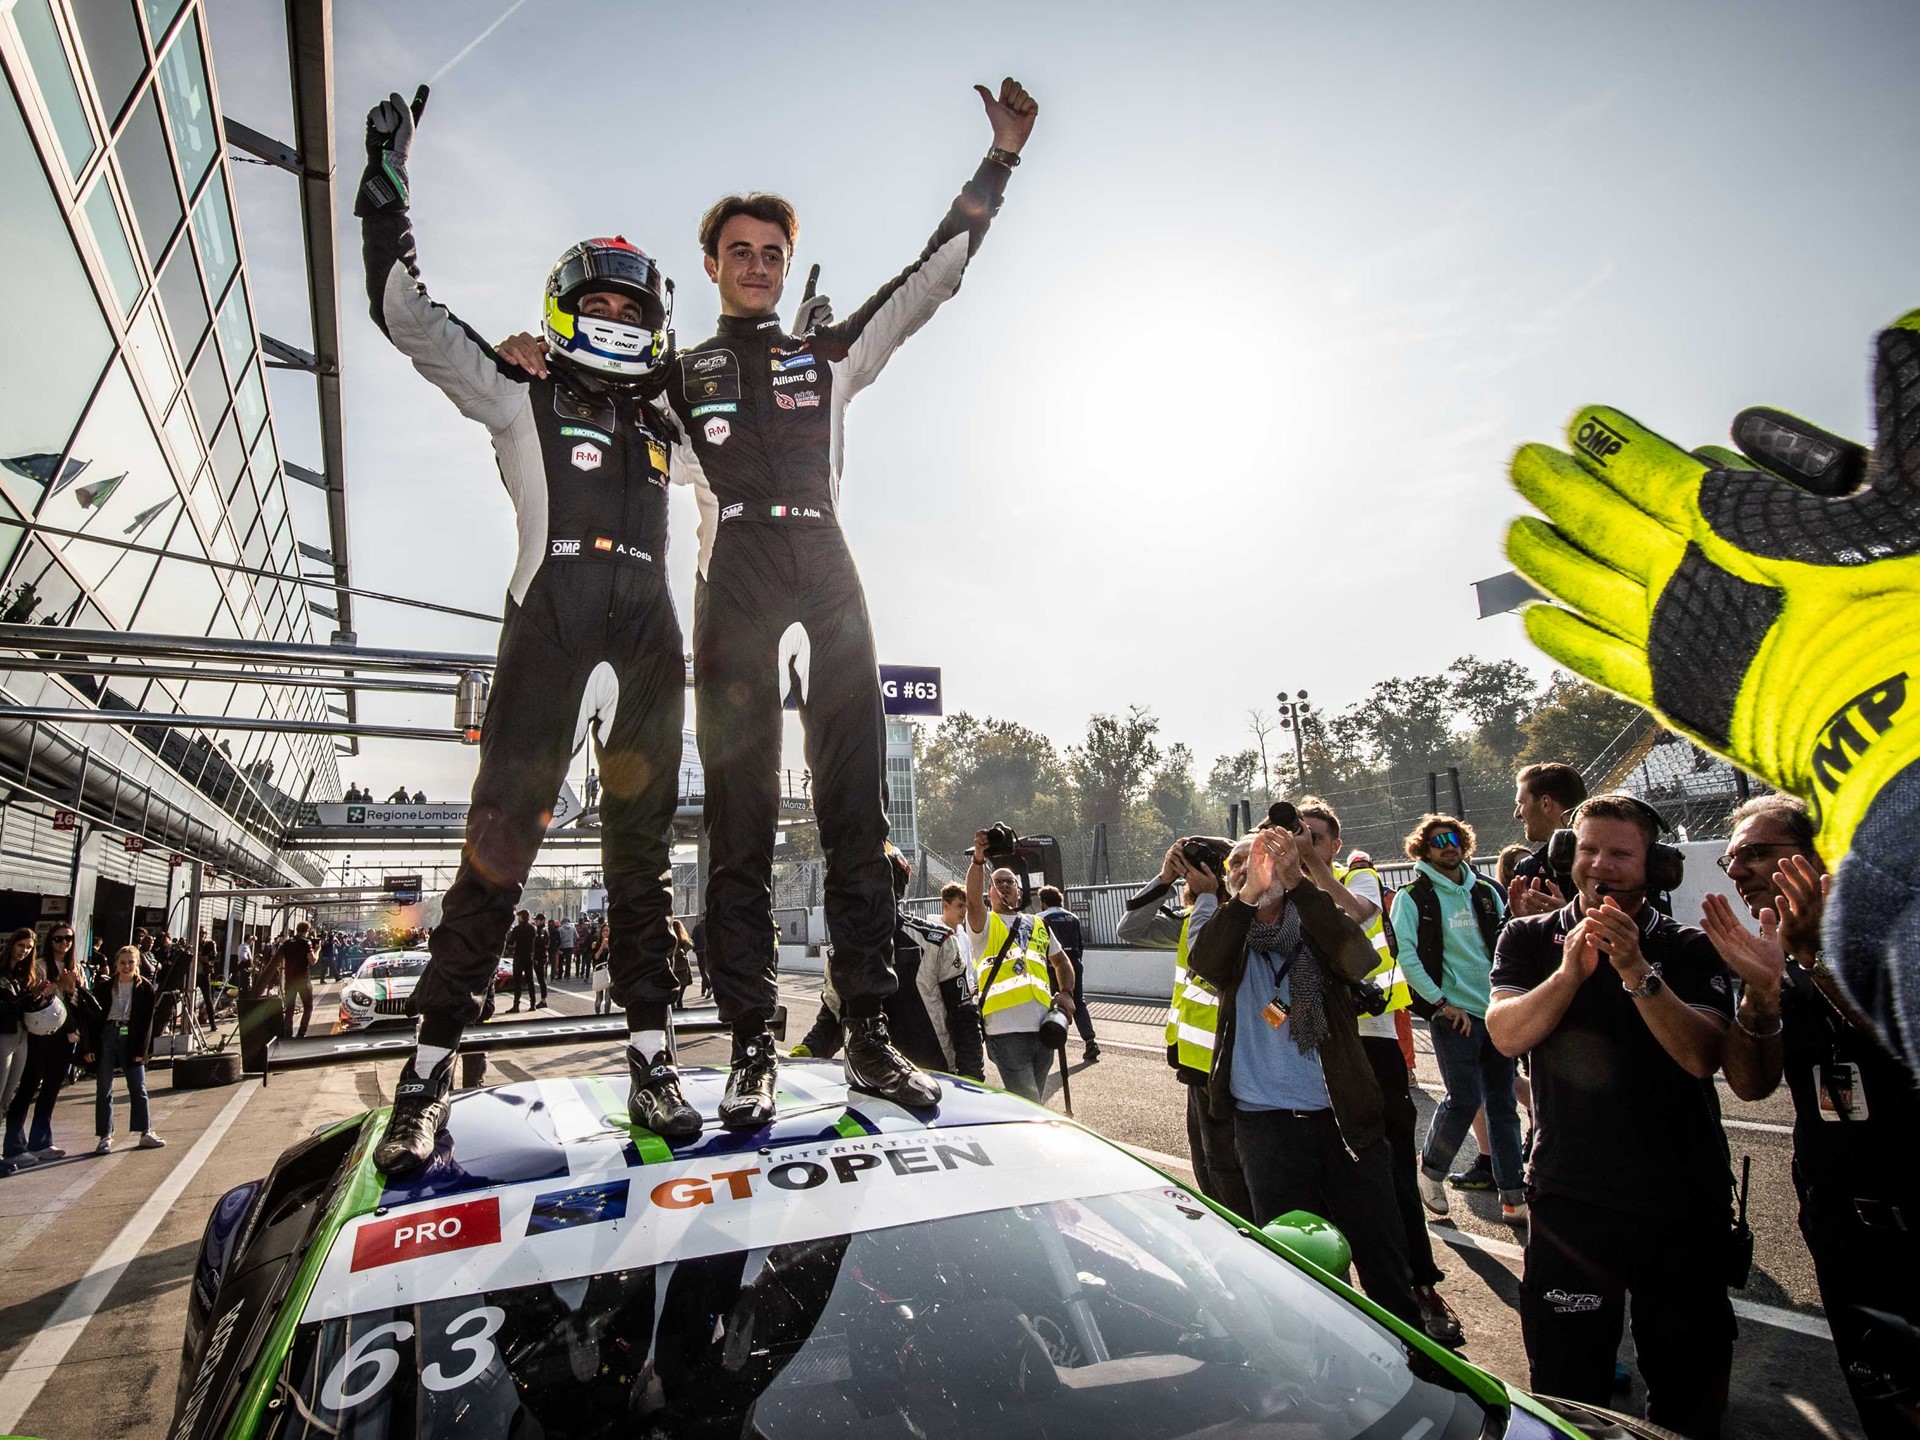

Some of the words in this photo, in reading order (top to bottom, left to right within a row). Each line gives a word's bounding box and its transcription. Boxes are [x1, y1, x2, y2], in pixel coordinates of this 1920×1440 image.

[772, 374, 805, 386] Allianz
[700, 403, 736, 415] MOTOREX
[573, 428, 612, 446] MOTOREX
[1576, 419, 1626, 462] OMP
[721, 503, 744, 520] OMP
[791, 507, 802, 516] G.
[551, 541, 581, 555] OMP
[616, 544, 627, 554] A.
[629, 547, 652, 562] Costa
[903, 681, 938, 700] #63
[782, 799, 806, 810] Monza
[54, 813, 75, 825] 16
[367, 810, 417, 821] Regione
[125, 838, 141, 848] 15
[170, 856, 182, 865] 14
[333, 1031, 530, 1051] ROER
[766, 1134, 979, 1164] INTERNATIONAL
[393, 1217, 462, 1249] PRO
[320, 1305, 506, 1411] 63
